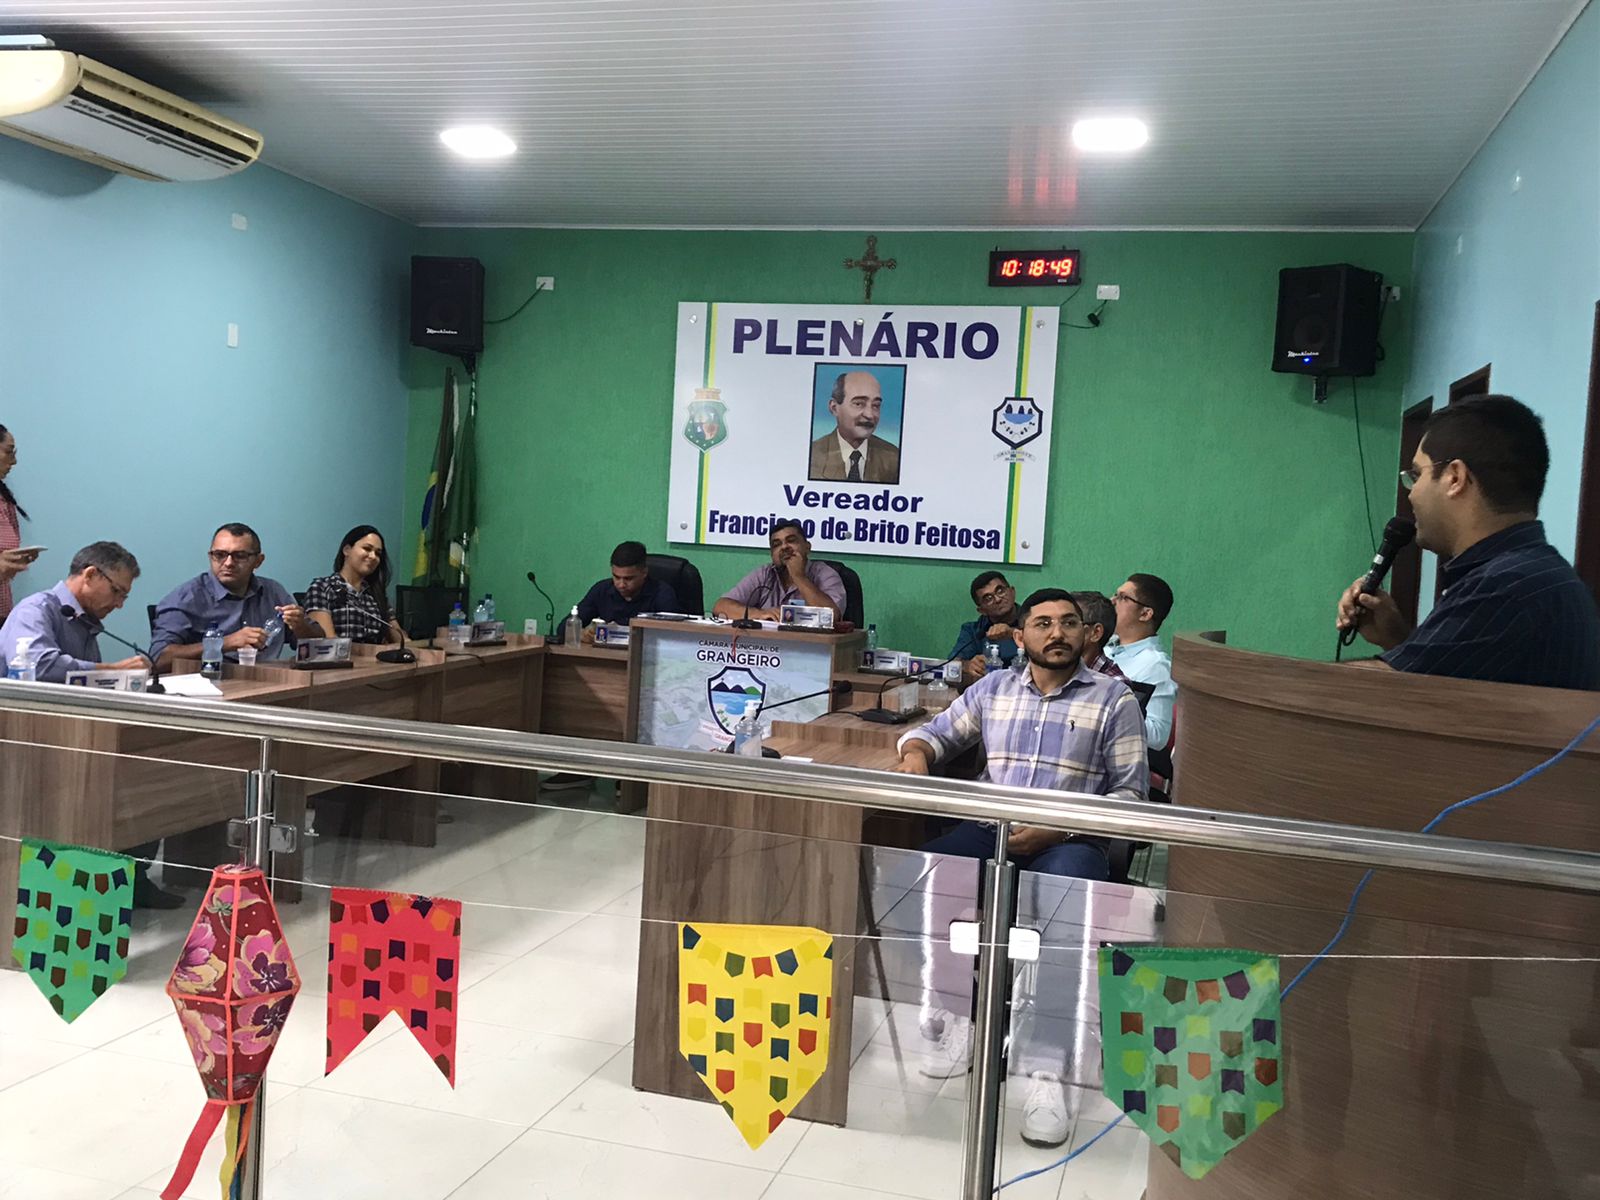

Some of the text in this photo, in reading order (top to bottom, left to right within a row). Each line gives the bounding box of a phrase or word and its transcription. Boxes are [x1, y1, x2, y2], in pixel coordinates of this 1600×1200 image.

[1001, 258, 1072, 277] 10:18:49
[732, 311, 999, 360] PLENÁRIO
[783, 484, 924, 513] Vereador
[708, 509, 1001, 550] Francio de Brito Feitosa
[698, 639, 729, 648] CÂMARA
[696, 649, 781, 668] GRANGEIRO
